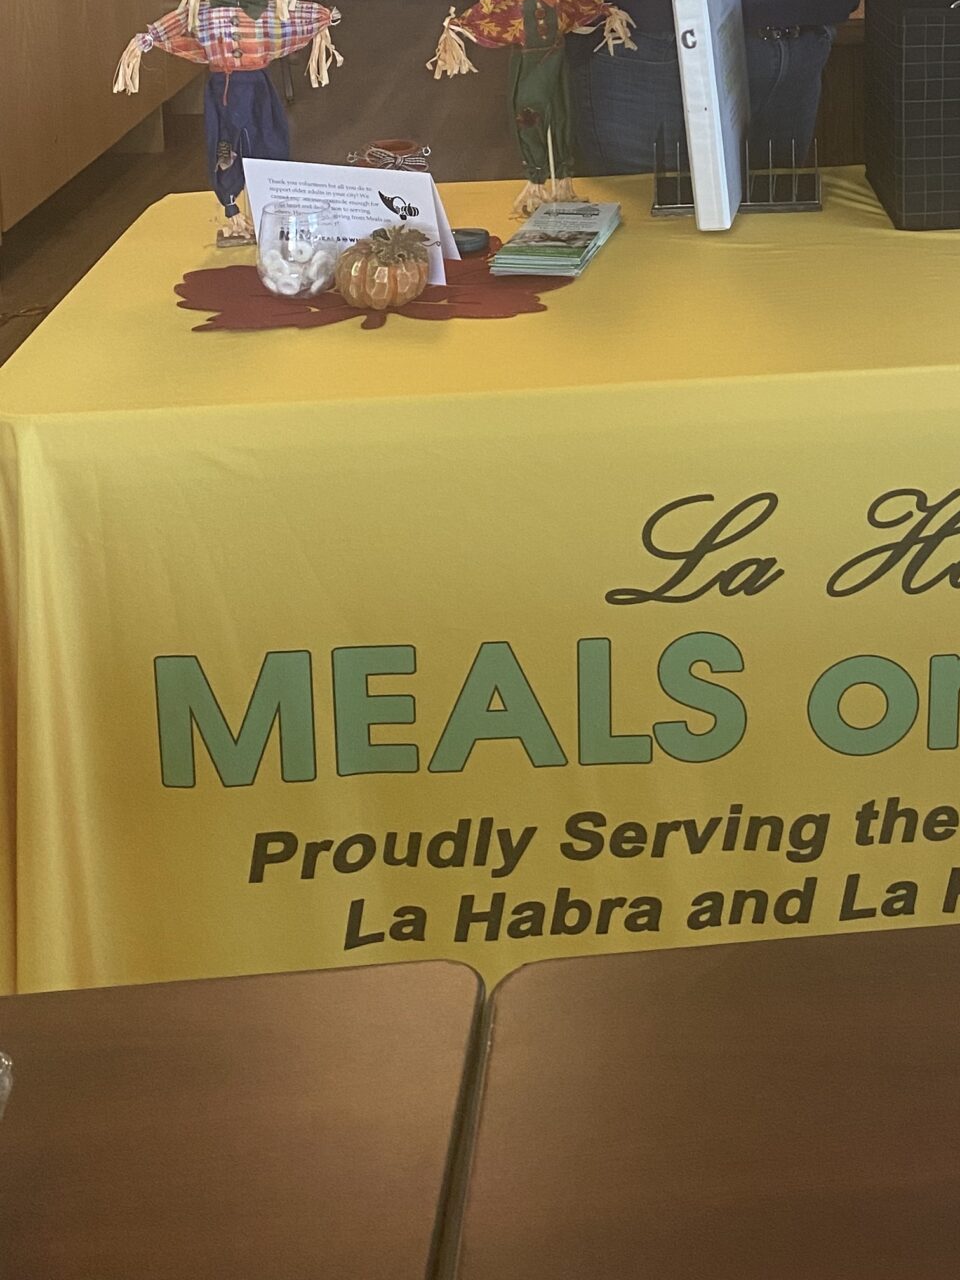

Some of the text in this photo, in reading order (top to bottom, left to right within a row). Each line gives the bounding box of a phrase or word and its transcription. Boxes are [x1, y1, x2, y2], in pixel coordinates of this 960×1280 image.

[681, 29, 697, 49] C
[605, 491, 784, 605] La
[153, 631, 748, 789] MEALS
[248, 817, 537, 884] Proudly
[559, 802, 831, 863] Serving
[853, 796, 960, 848] the
[344, 897, 426, 951] La
[453, 886, 662, 943] Habra
[686, 877, 817, 931] and
[839, 872, 918, 924] La
